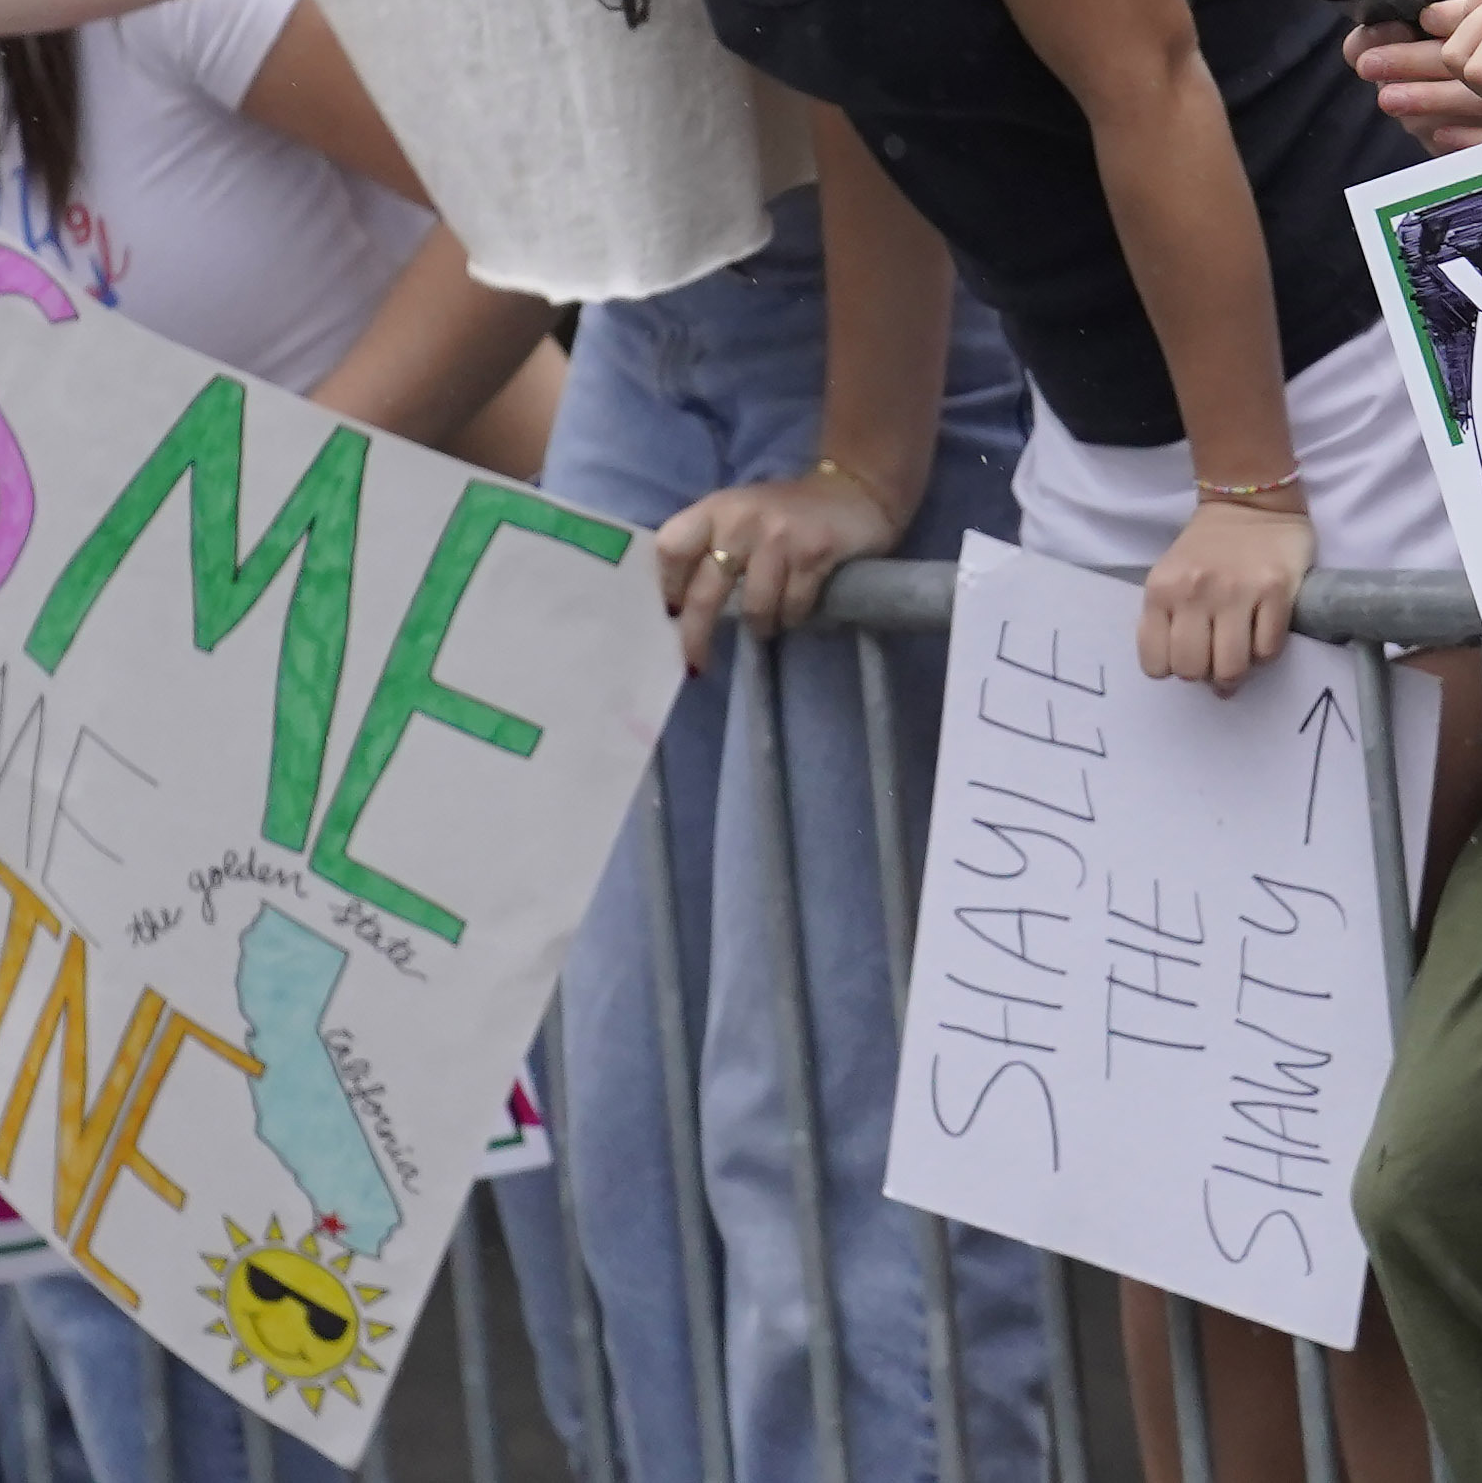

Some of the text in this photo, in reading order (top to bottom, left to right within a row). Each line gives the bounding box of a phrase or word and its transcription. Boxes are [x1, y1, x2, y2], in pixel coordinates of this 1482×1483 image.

[24, 374, 632, 943] ME
[126, 906, 184, 946] the
[187, 847, 309, 925] golden
[932, 620, 1107, 1172] SHAYLEE
[1105, 871, 1207, 1080] THE
[1205, 873, 1346, 1276] SHAWTY
